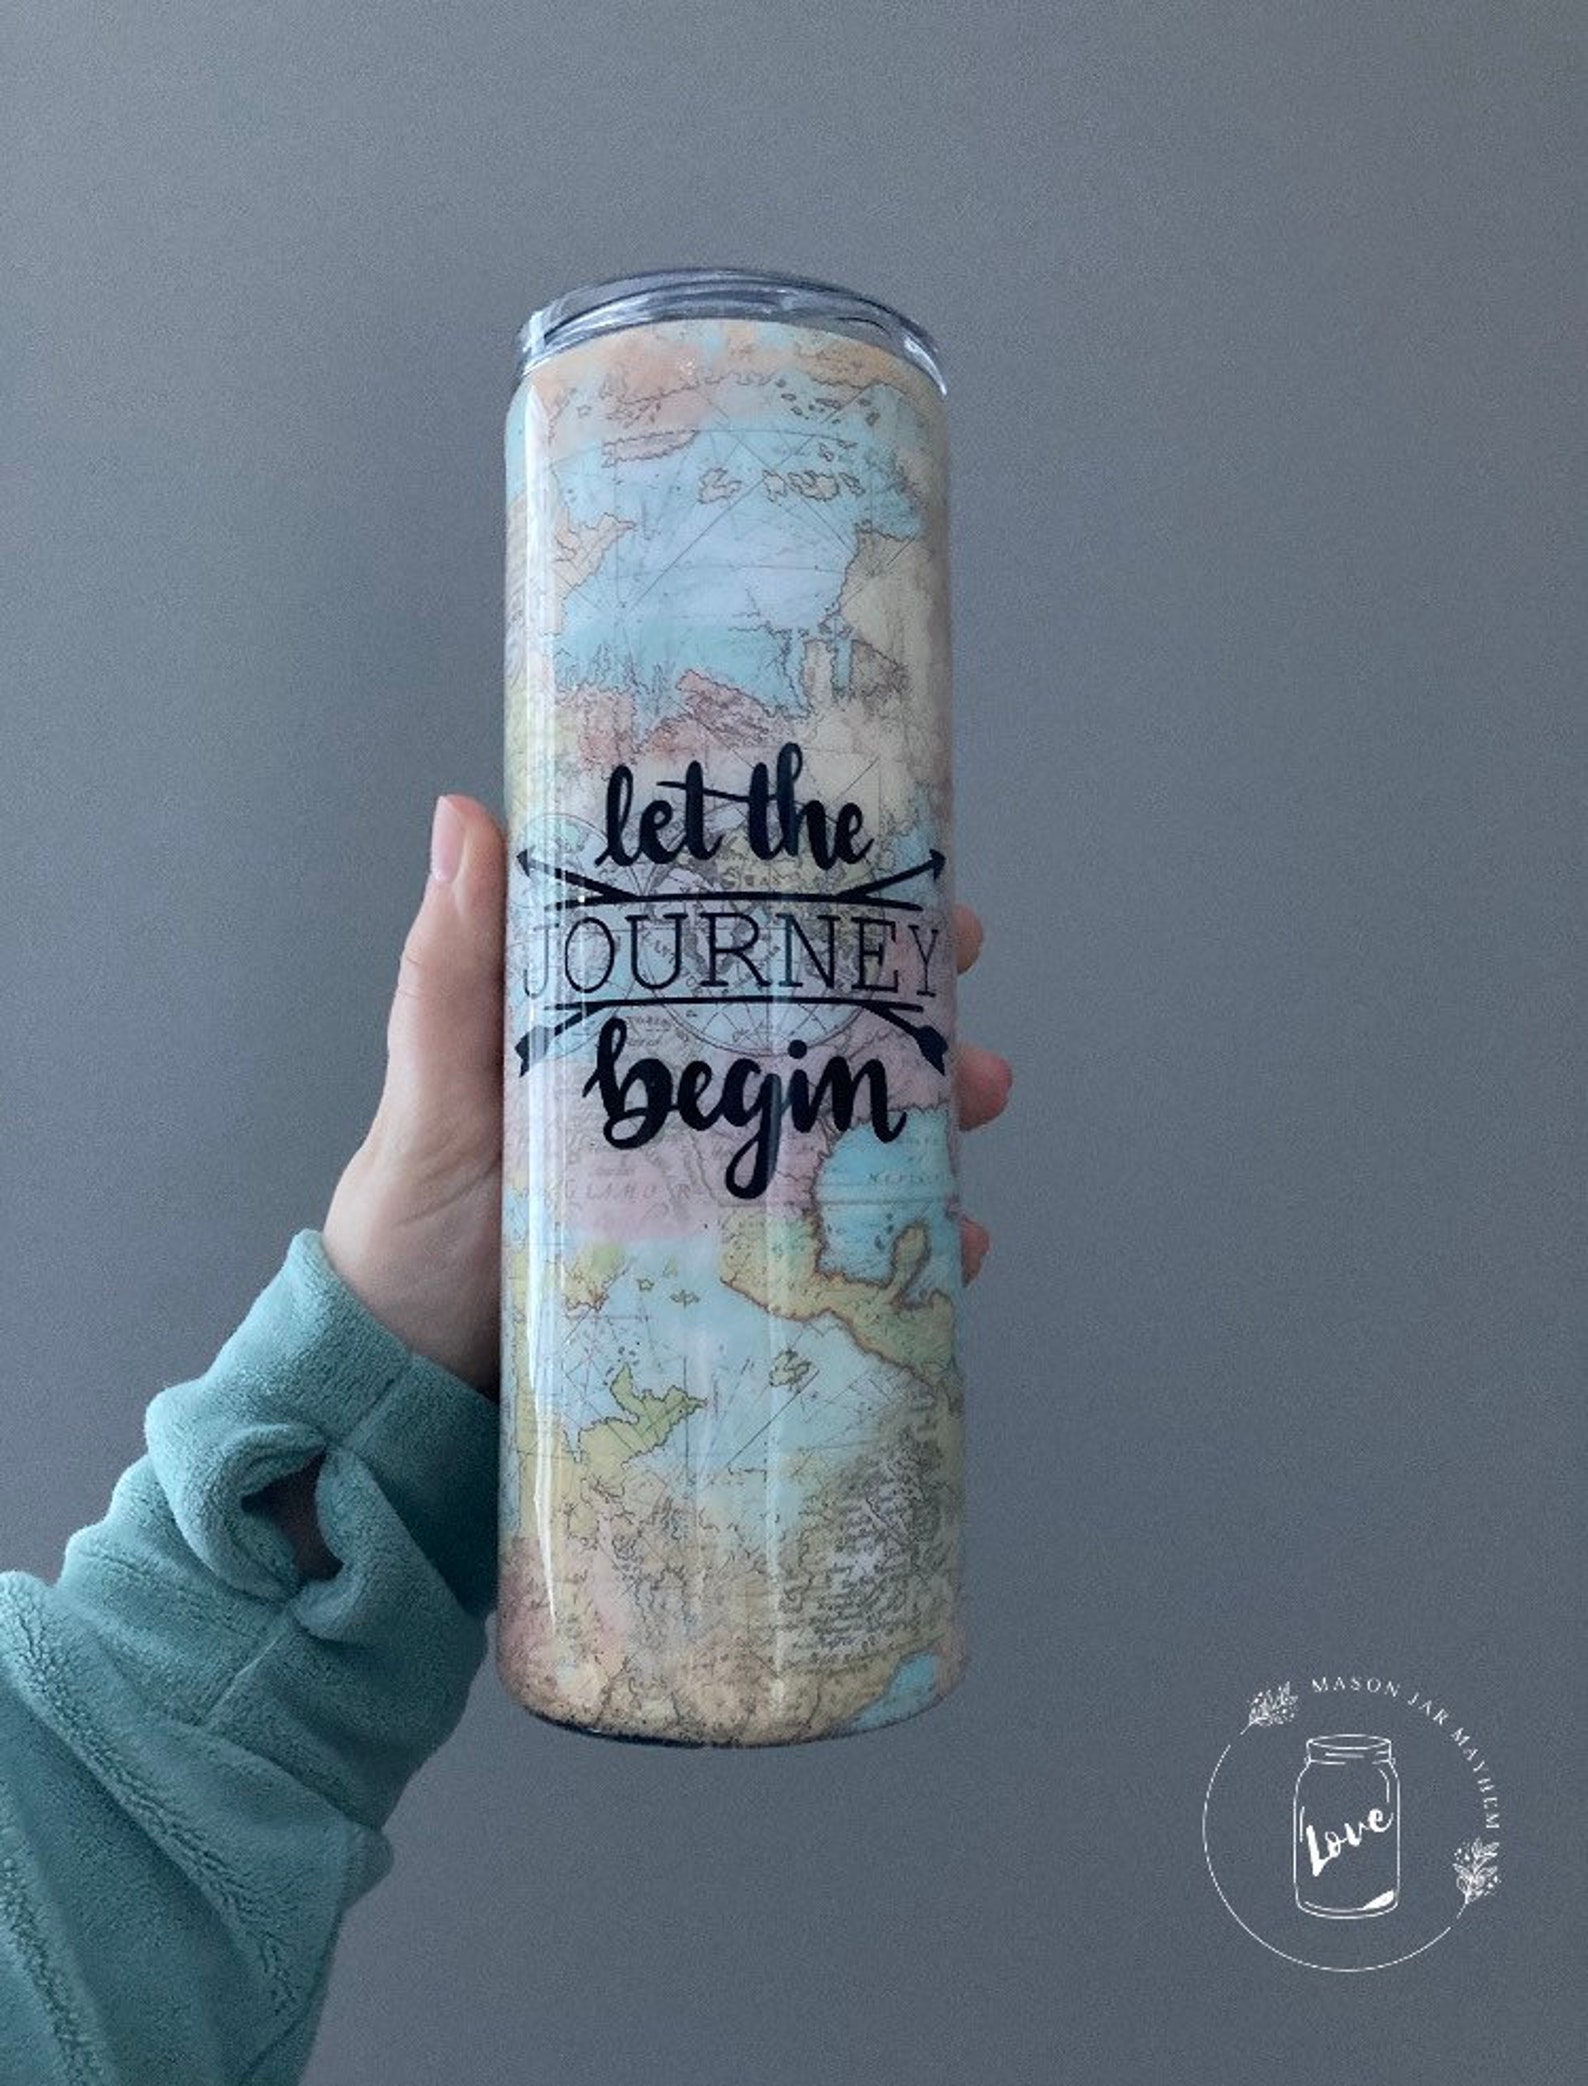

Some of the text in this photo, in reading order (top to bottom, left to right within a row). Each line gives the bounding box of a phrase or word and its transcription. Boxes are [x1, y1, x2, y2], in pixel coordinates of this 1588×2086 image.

[595, 743, 873, 869] let the
[523, 912, 938, 998] JOURNEY
[583, 1018, 907, 1199] begin
